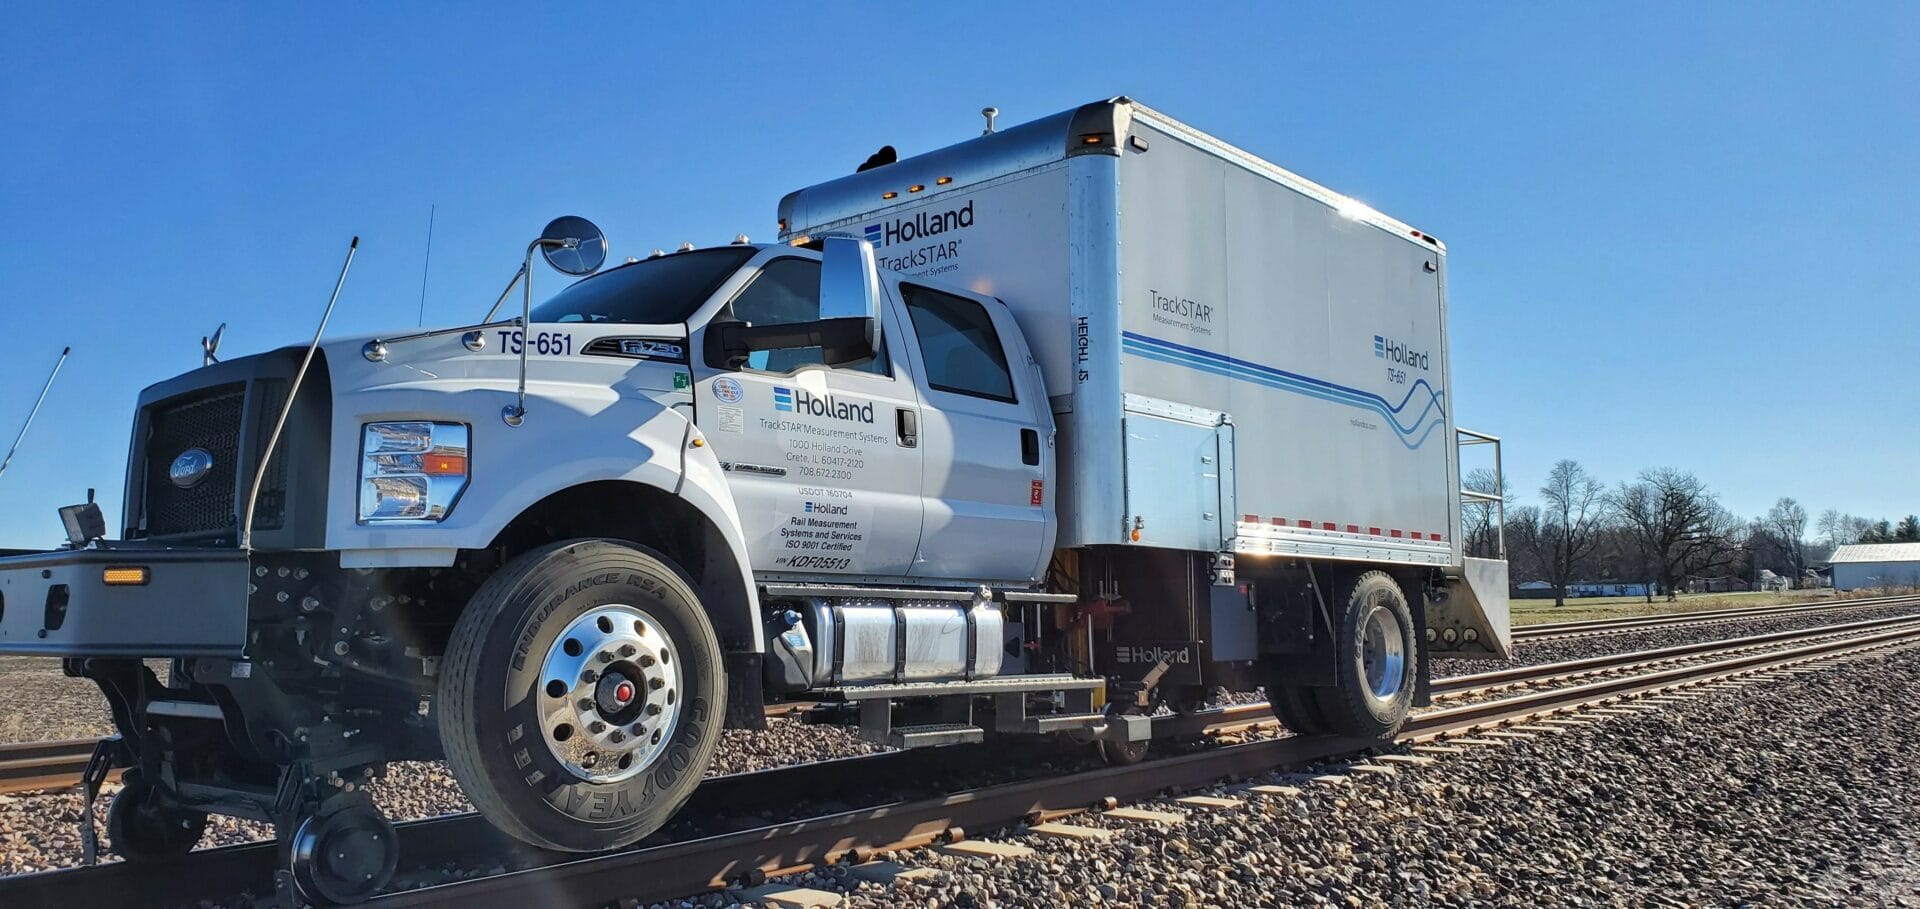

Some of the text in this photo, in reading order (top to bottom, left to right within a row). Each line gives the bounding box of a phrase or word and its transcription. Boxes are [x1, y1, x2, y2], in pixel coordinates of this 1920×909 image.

[885, 199, 974, 246] Holland
[930, 263, 959, 277] Systems
[1153, 313, 1211, 336] Measurement Systems
[498, 331, 571, 355] TS-651
[1385, 338, 1429, 371] Holland
[1387, 367, 1406, 385] TS-651
[795, 390, 874, 424] Holland
[803, 425, 858, 440] Measurement
[859, 431, 889, 444] Systems
[789, 439, 863, 456] 1000 Holland Drive
[174, 456, 198, 477] Ford
[786, 452, 864, 468] Crete, IL 60417-2120
[799, 466, 852, 480] 708.672.2300
[798, 487, 824, 496] USDOT
[813, 503, 848, 515] Holland
[791, 516, 857, 530] Rail Measurement
[780, 527, 862, 541] Systems and Services
[785, 539, 853, 551] ISO 9001 Certified
[787, 555, 851, 570] KDF05513
[512, 573, 667, 671] ENDURANCE RSA
[1131, 646, 1189, 664] Holland
